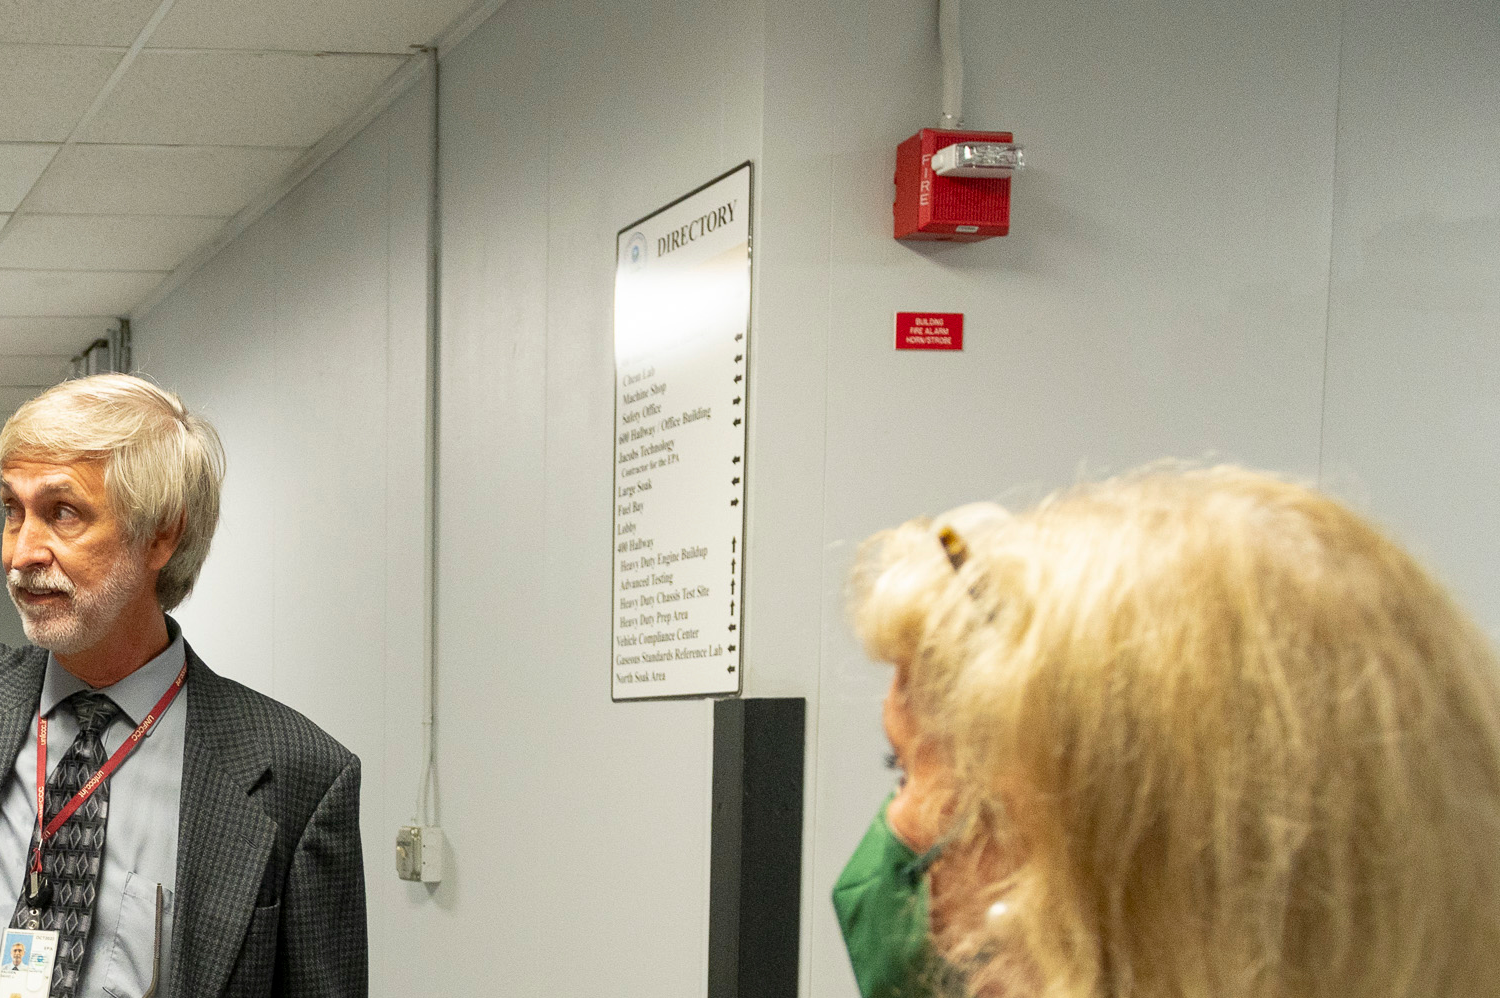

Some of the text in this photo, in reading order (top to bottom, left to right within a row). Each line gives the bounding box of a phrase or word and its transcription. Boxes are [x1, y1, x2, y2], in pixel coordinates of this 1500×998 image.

[920, 154, 932, 206] FIRE
[657, 199, 737, 257] DIRECTORY
[909, 326, 950, 335] FIRE ALARM
[915, 317, 944, 326] BUILDING
[905, 335, 952, 345] HORN/STROBE
[643, 365, 655, 380] Lab
[623, 382, 667, 404] Machine Shop
[622, 403, 662, 425] Safety Office
[631, 425, 655, 441] Hallway
[661, 416, 681, 431] Office
[682, 407, 712, 424] Building
[618, 439, 675, 464] Jacobs Technology
[618, 478, 652, 498] Large Soak
[618, 500, 644, 517] Fuel Bay
[617, 521, 637, 535] Lobby
[629, 537, 654, 551] Hallway
[620, 560, 639, 573] Heavy
[640, 556, 655, 570] Duty
[657, 550, 680, 566] Engine
[620, 571, 674, 591] Advanced Testing
[620, 584, 710, 611] Heavy Duty Chassis Test Site
[620, 610, 689, 629] Heavy Duty Prep Area
[616, 627, 700, 647] Vehicle Compliance Center
[642, 649, 673, 661] Standards
[674, 647, 707, 660] Reference
[708, 643, 723, 657] Lab
[616, 670, 666, 684] North Soak Area
[131, 714, 155, 742] UNFCCC
[78, 770, 105, 799] unfccc.int
